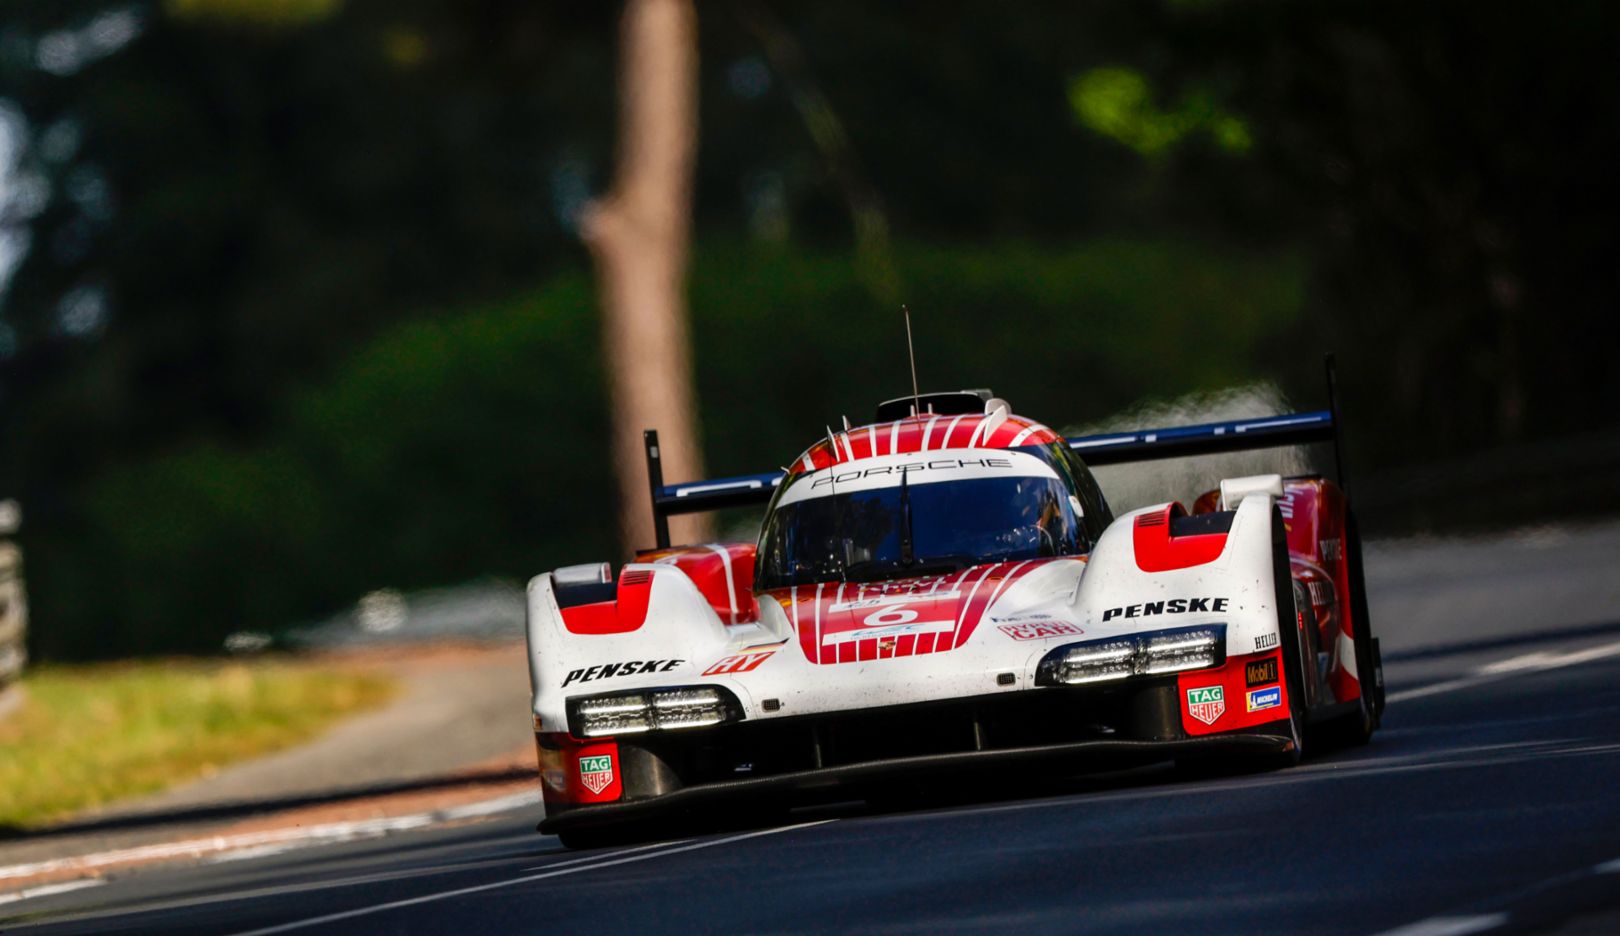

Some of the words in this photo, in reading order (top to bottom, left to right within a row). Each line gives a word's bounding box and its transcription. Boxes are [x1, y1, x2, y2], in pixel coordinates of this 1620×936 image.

[811, 459, 1013, 489] PORSCHE
[863, 603, 919, 626] 6
[1102, 598, 1229, 622] PENSKE
[1013, 626, 1076, 639] CAR
[561, 660, 685, 688] PENSKE
[1247, 663, 1269, 684] Mobil
[1190, 688, 1221, 703] TAG
[1191, 702, 1223, 722] HEUER
[581, 758, 609, 771] TAG
[582, 772, 610, 792] HEUER
